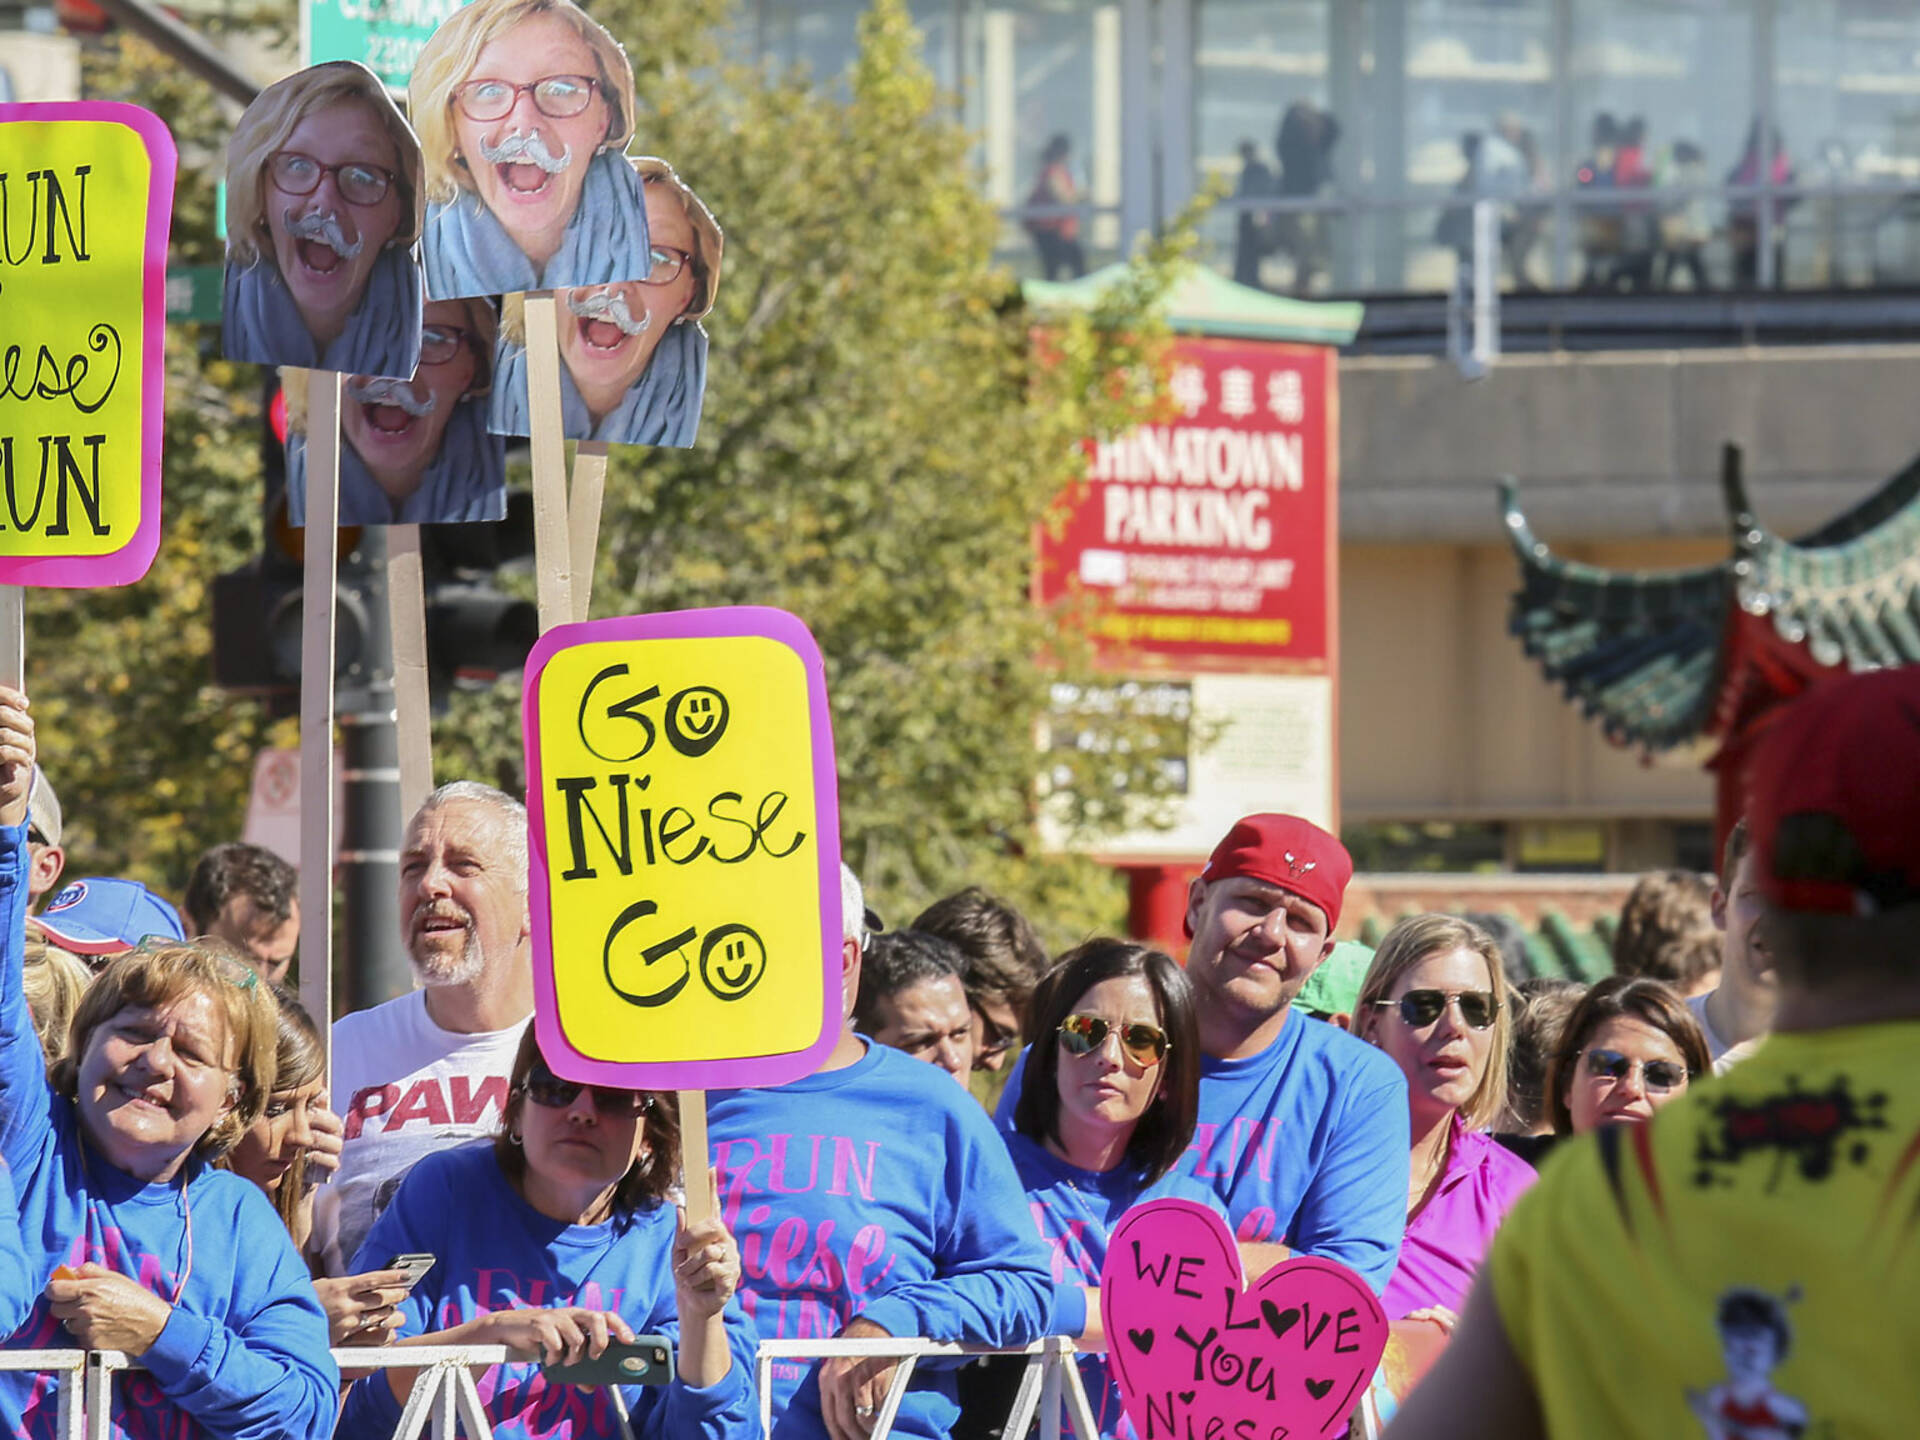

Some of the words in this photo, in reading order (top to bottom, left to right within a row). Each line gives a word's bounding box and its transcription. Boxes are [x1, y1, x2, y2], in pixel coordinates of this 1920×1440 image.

[0, 165, 91, 265] UN
[0, 324, 121, 413] ese
[0, 434, 110, 536] UN
[1086, 427, 1303, 491] HINATOWN
[1104, 485, 1271, 550] PARKING
[713, 1133, 881, 1201] RUN
[1132, 1240, 1205, 1299] WE
